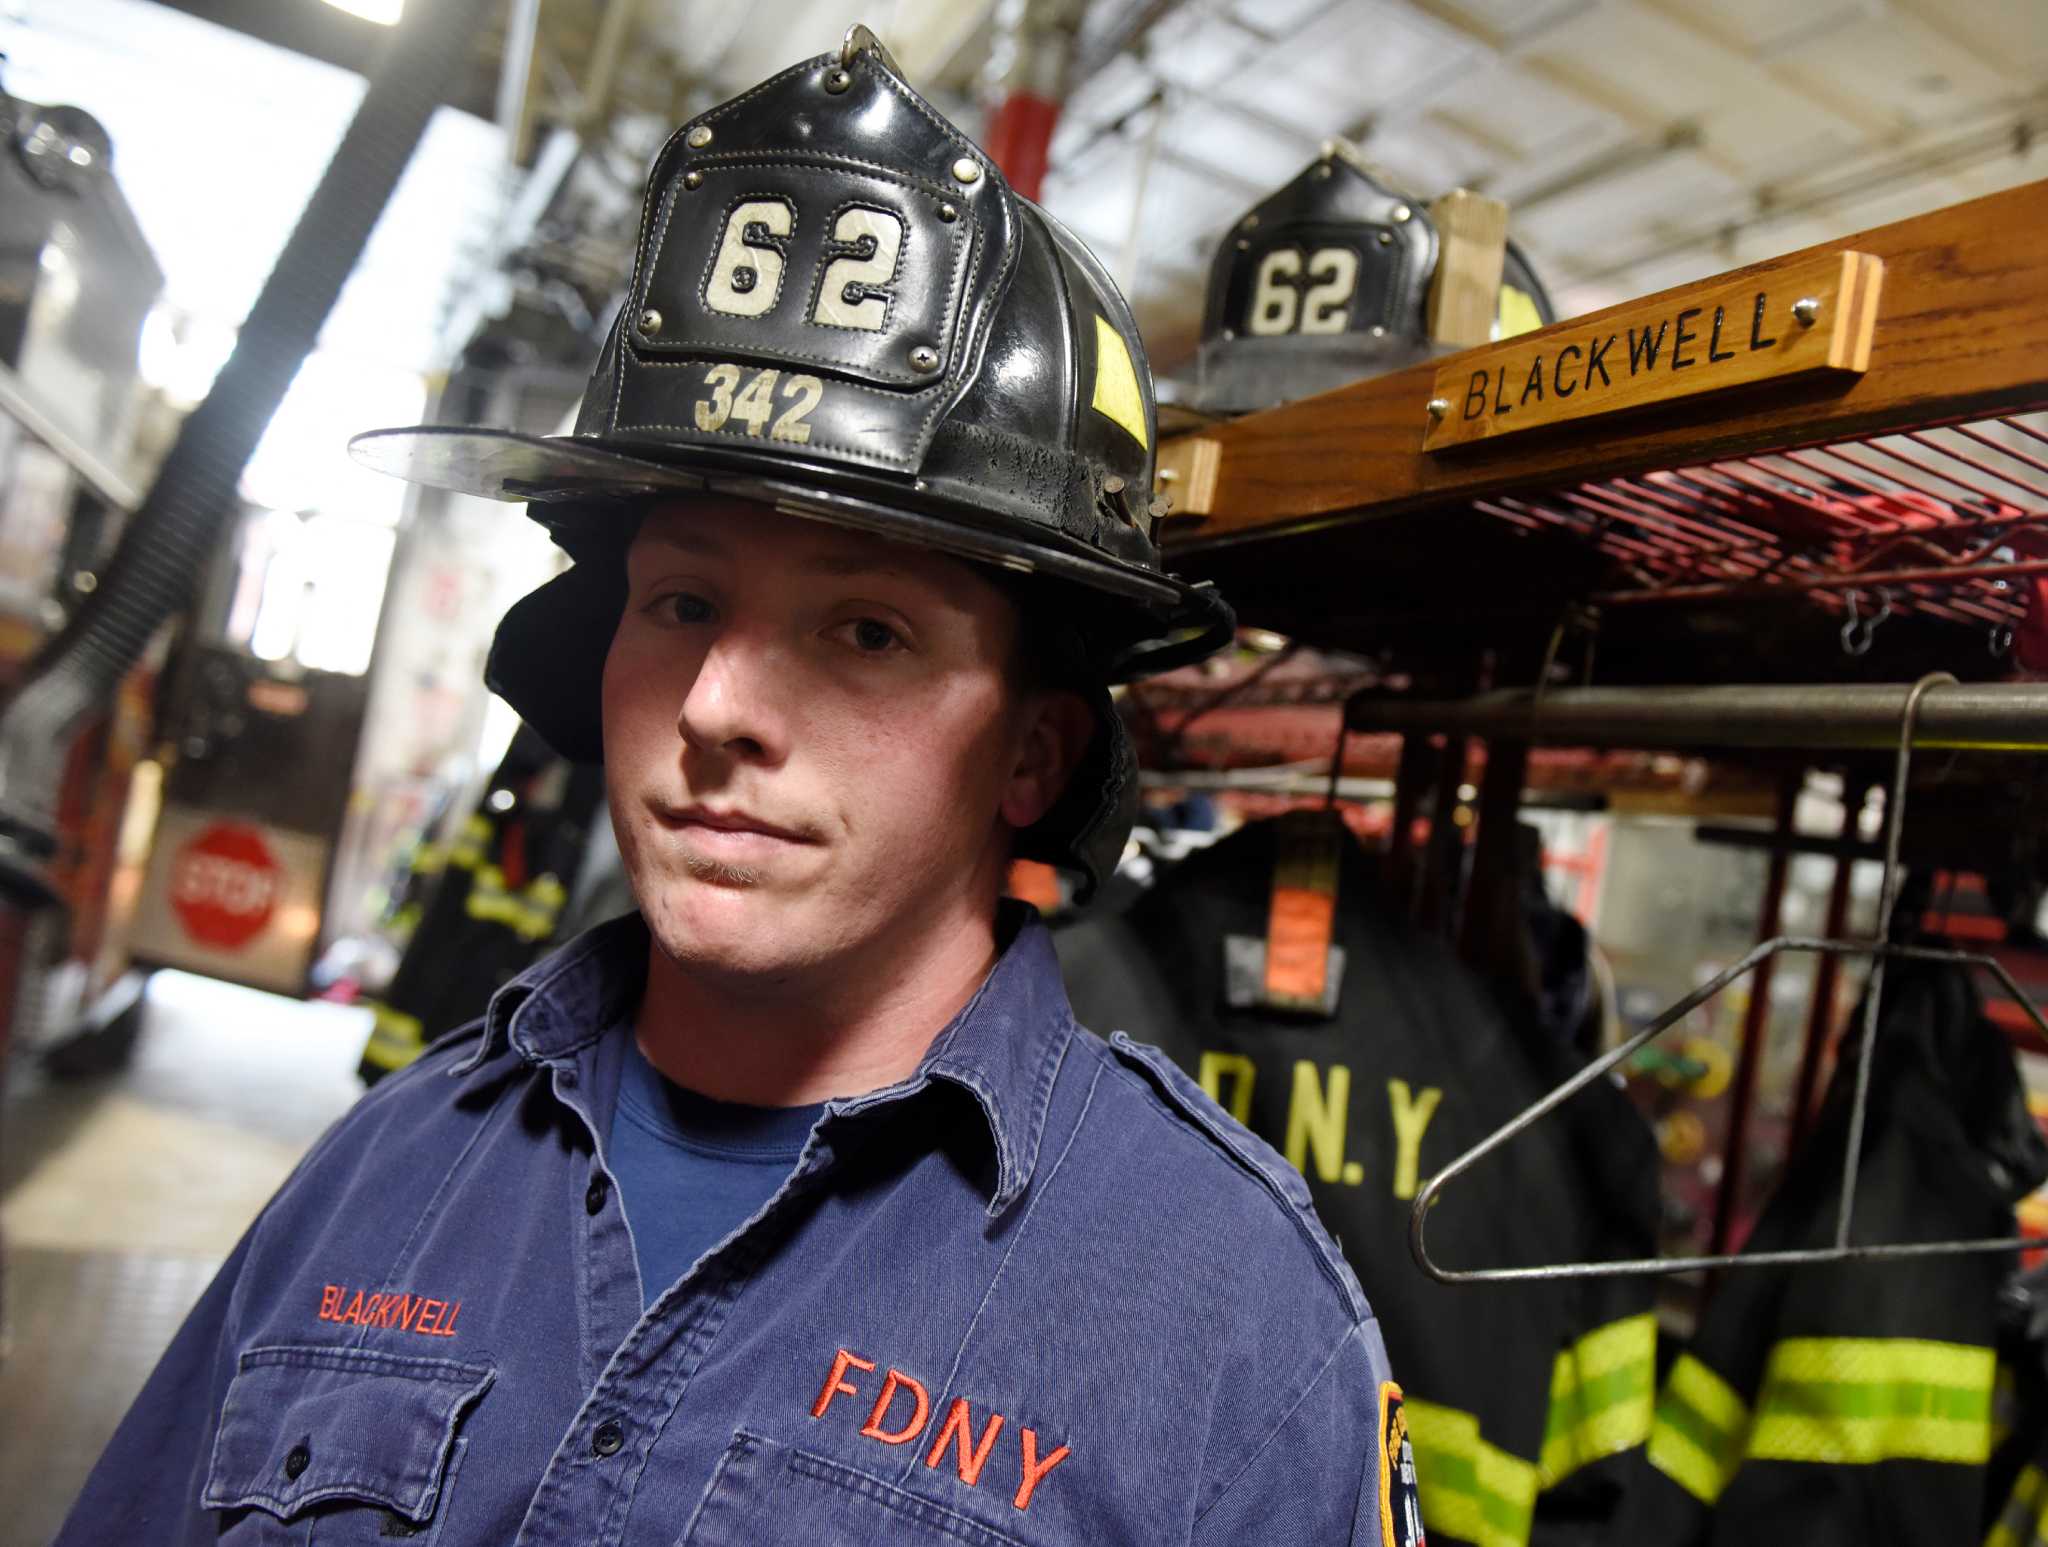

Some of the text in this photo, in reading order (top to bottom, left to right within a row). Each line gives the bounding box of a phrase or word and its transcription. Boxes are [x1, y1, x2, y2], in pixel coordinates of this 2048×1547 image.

[704, 200, 904, 332] 62
[1251, 247, 1357, 336] 62
[1463, 291, 1777, 421] BLACKWELL
[695, 363, 823, 444] 342
[181, 854, 275, 914] STOP
[319, 1284, 461, 1336] BLACKWELL
[810, 1348, 1071, 1511] FDNY
